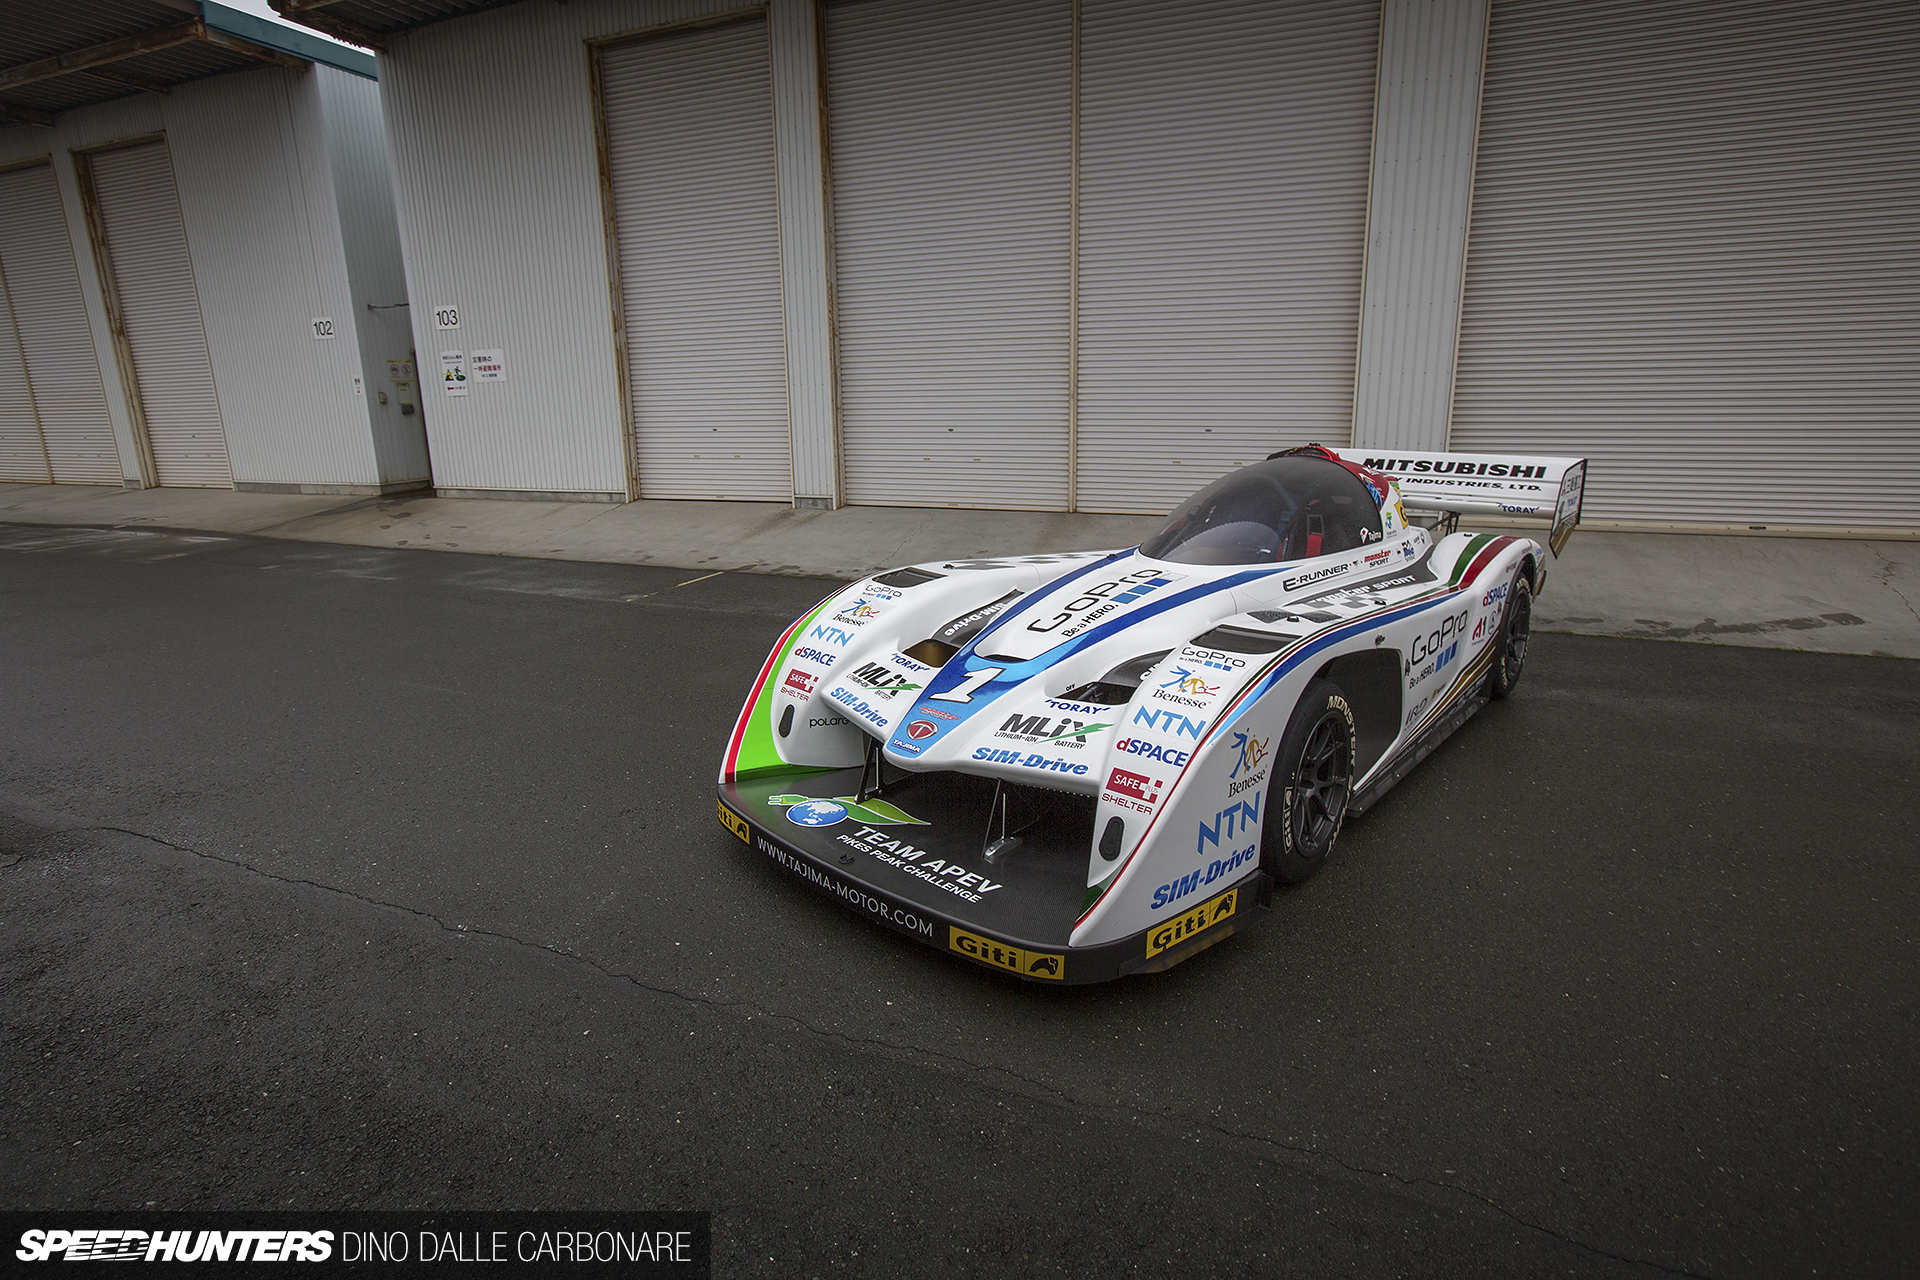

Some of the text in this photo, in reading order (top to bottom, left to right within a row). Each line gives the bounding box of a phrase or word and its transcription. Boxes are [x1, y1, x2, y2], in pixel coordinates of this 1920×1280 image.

[313, 320, 333, 336] 102
[436, 309, 458, 326] 103
[1363, 458, 1548, 479] MITSUBISHI
[1509, 484, 1542, 492] LTD.
[1364, 549, 1391, 563] monster
[1369, 557, 1389, 568] SPORT
[866, 584, 902, 597] GoPro
[1027, 568, 1163, 633] GoPro
[1482, 582, 1508, 607] dSPACE
[832, 613, 865, 627] Benesse
[1061, 627, 1080, 637] Be
[1081, 603, 1119, 624] HERO.
[810, 624, 855, 647] NTN
[1411, 610, 1468, 666] GoPro
[794, 647, 836, 667] dSPACE
[891, 652, 930, 672] TORAY
[1181, 646, 1246, 668] GoPro
[789, 673, 806, 685] SAFE
[927, 667, 1006, 704] 1
[780, 686, 810, 702] SHELTER
[1152, 688, 1208, 710] Benesse
[830, 686, 889, 728] SIM-Drive
[1045, 699, 1110, 714] TORAY
[1133, 705, 1207, 741] NTN
[892, 738, 921, 753] TAJIMA
[1054, 740, 1086, 750] BATTERY
[1116, 737, 1190, 768] dSPACE
[972, 747, 1089, 775] SIM-Drive
[1113, 774, 1140, 790] SAFE
[1145, 782, 1159, 794] PLUS
[1228, 768, 1266, 799] Benesse
[1101, 792, 1153, 816] SHELTER
[717, 805, 733, 828] iti
[1196, 790, 1261, 856] NTN
[836, 834, 983, 904] PIKES PEAK CHALLENGE
[853, 826, 1003, 893] TEAM APEV
[757, 835, 933, 938] WWW.TAJIMA-MOTOR.COM
[1150, 843, 1256, 911] SIM-Drive
[1152, 909, 1206, 950] Giti
[955, 934, 1018, 969] Giti
